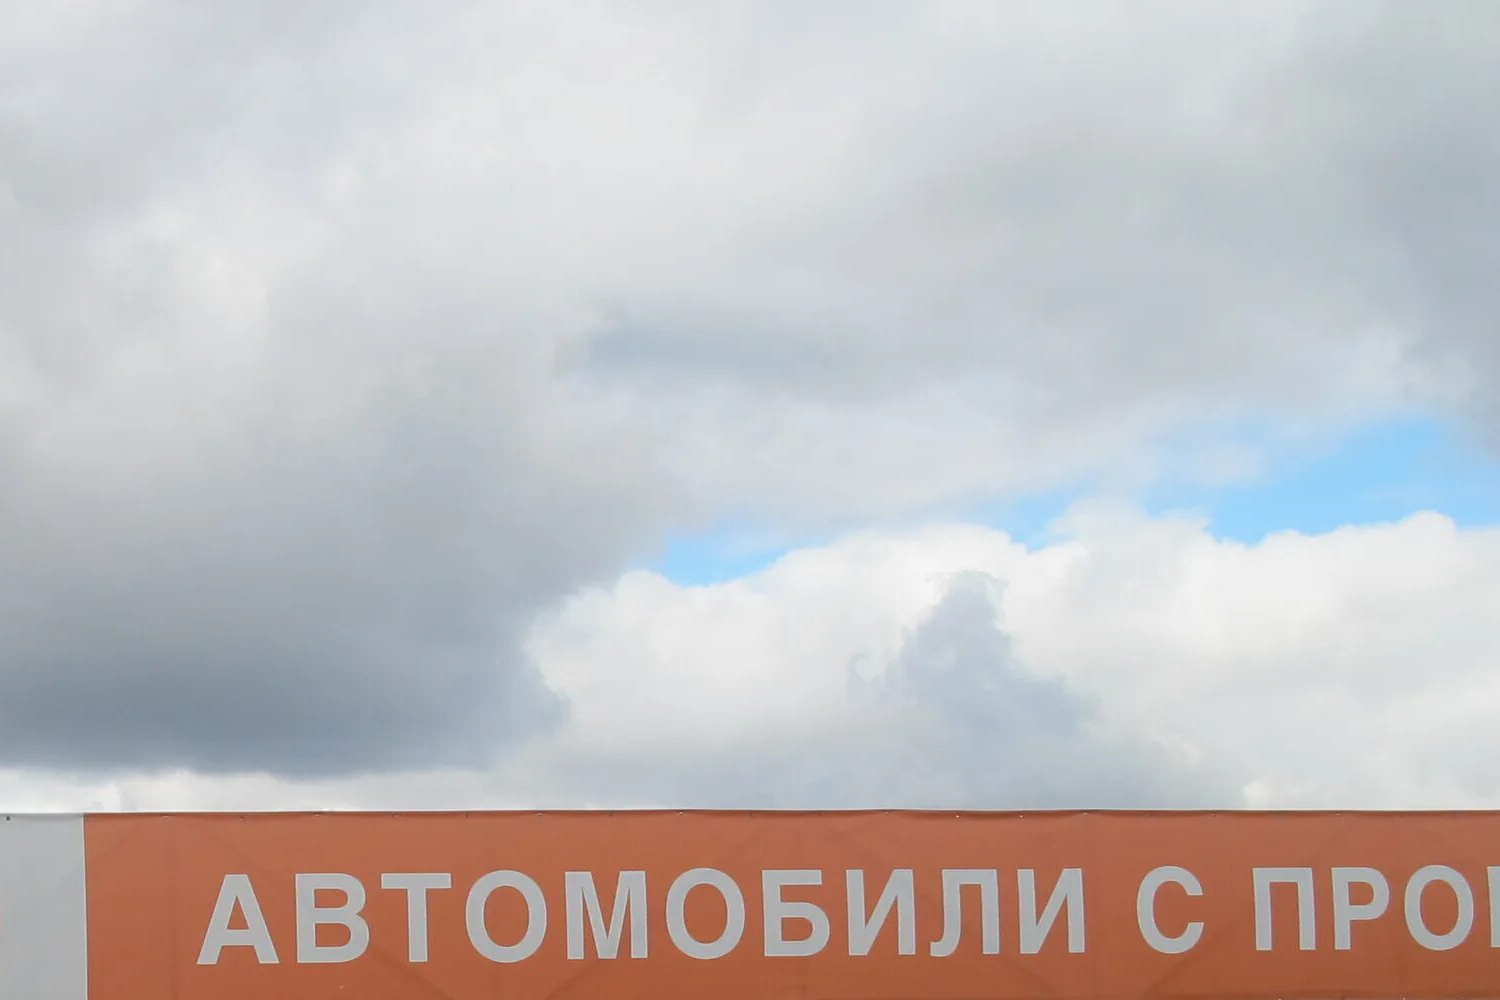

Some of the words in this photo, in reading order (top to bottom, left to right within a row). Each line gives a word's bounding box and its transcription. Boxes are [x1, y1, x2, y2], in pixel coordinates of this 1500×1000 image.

[196, 866, 1087, 965] АВТОМОБИЛИ
[1136, 865, 1205, 955] С
[1252, 864, 1500, 951] ПРО
